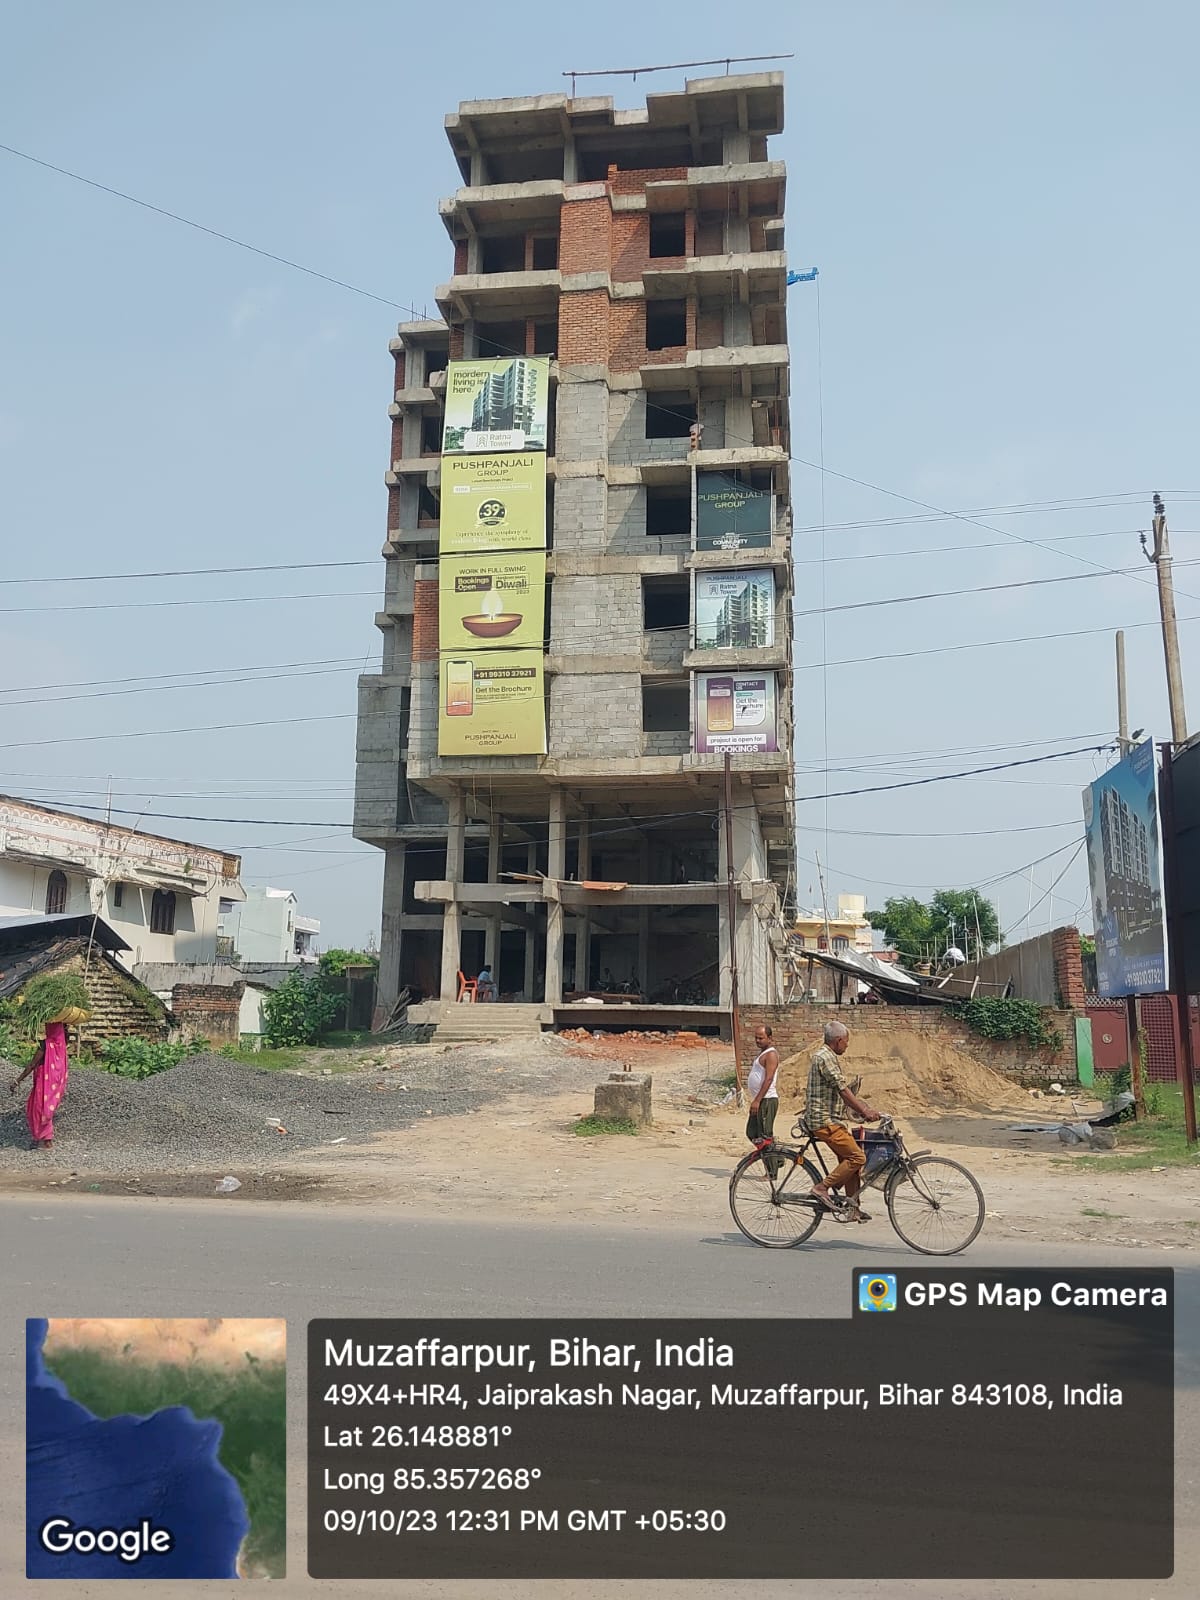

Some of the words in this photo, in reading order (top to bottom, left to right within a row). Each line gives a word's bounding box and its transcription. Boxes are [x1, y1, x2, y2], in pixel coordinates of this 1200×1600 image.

[453, 378, 475, 387] living
[452, 386, 474, 394] here.
[453, 459, 534, 470] PUSHPANJALI
[477, 469, 509, 477] GROUP
[698, 491, 763, 501] PUSHPANJALI
[715, 501, 746, 509] GROUP
[504, 565, 526, 573] SWING
[457, 577, 490, 586] Bookings
[496, 579, 527, 589] Diwali
[457, 584, 477, 592] Open
[501, 685, 533, 693] Brochure
[465, 733, 517, 741] PUSHPANJALI
[711, 736, 731, 744] project
[714, 745, 759, 753] BOOKINGS
